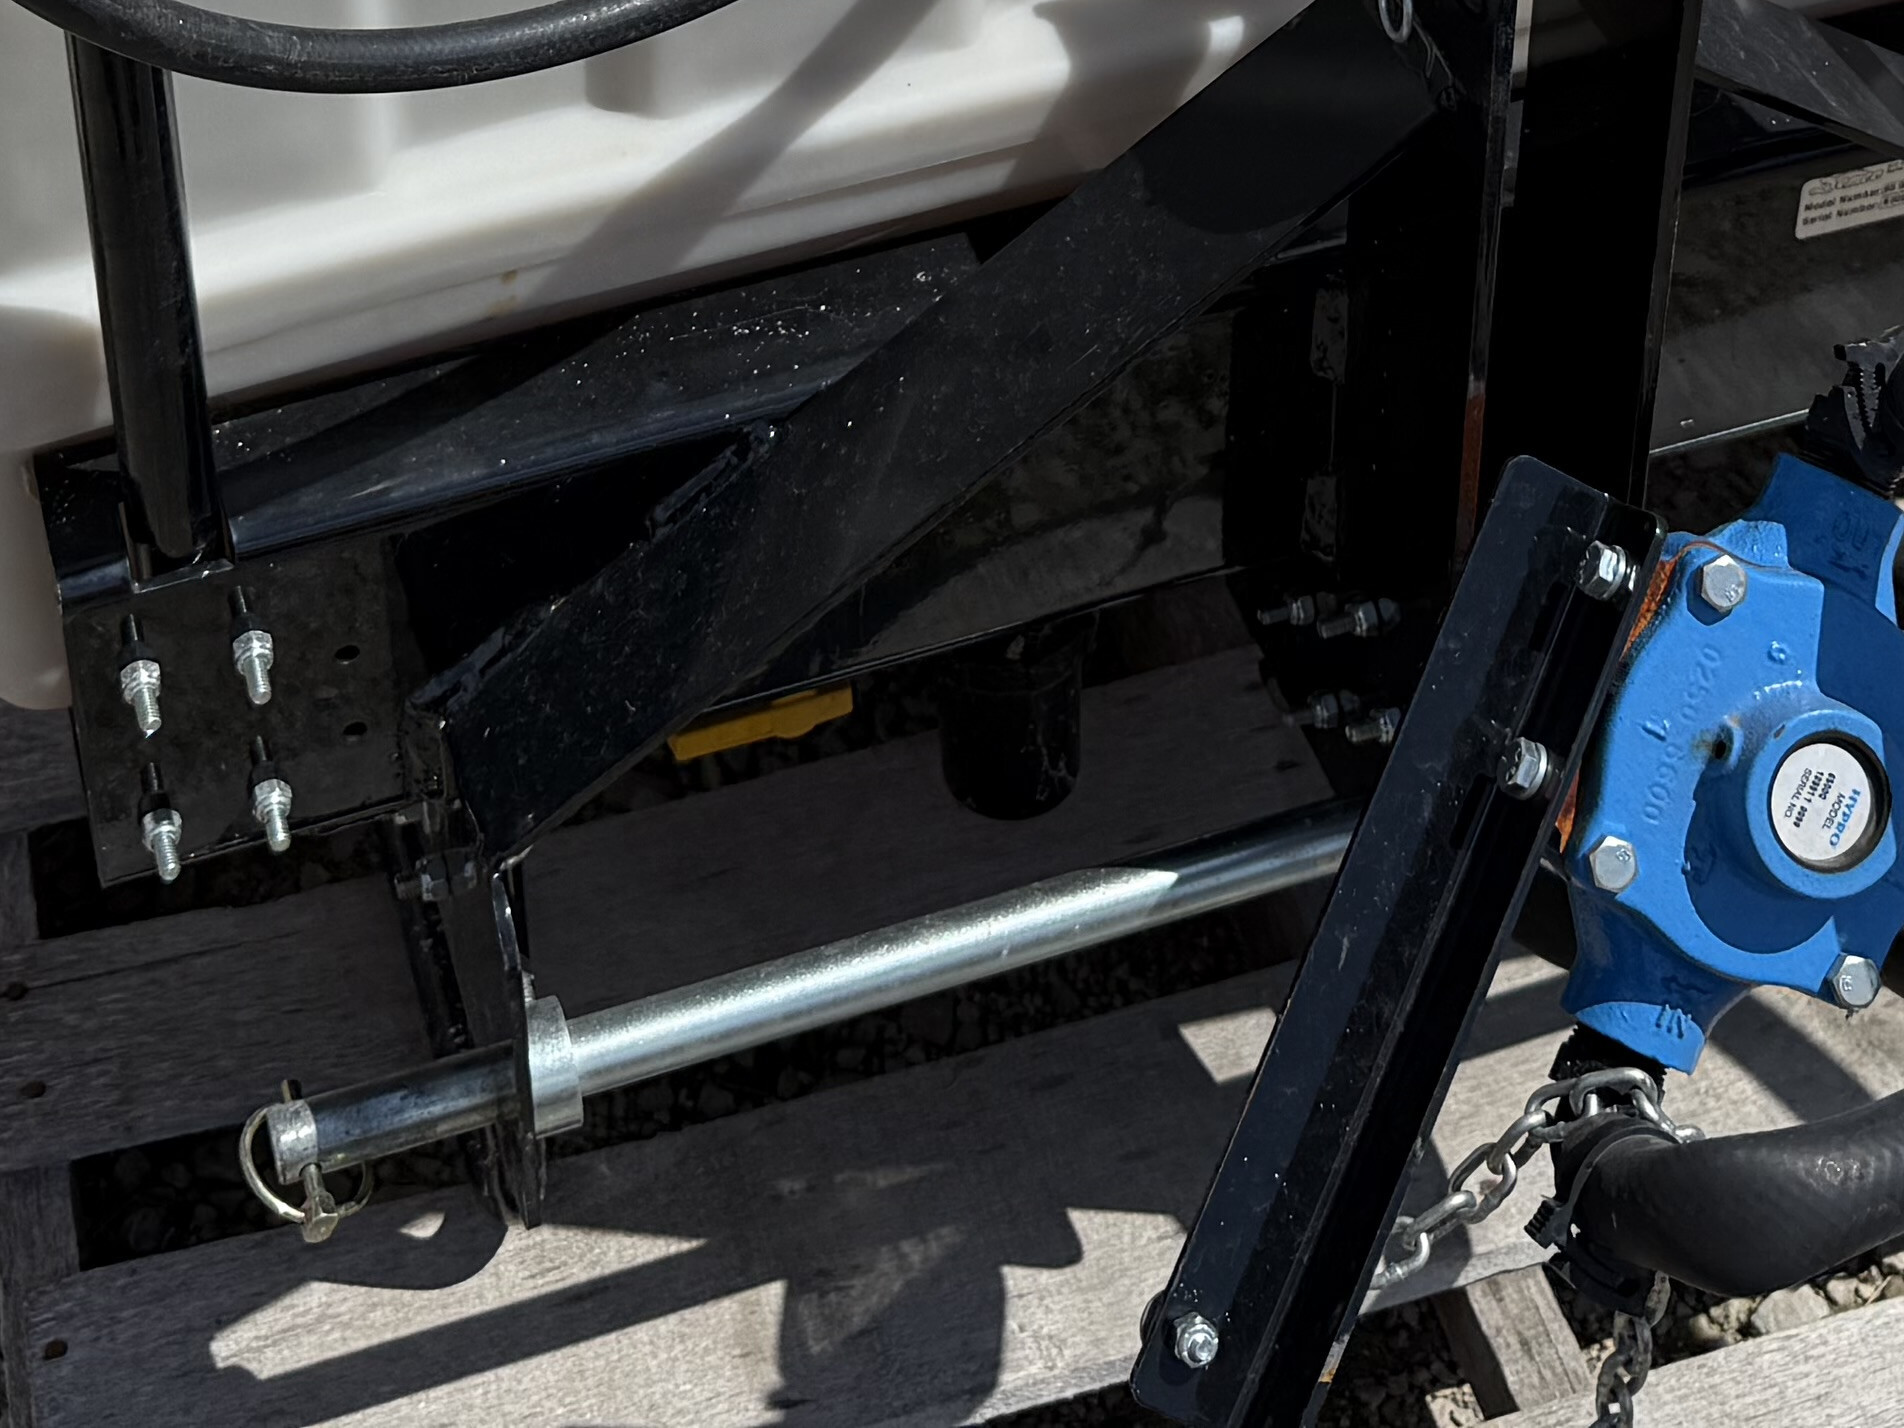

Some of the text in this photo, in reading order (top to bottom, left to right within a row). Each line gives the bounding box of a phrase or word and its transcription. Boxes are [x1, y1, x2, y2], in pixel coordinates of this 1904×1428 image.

[1791, 768, 1813, 800] SERIAL
[1821, 792, 1846, 830] MODEL
[1828, 788, 1861, 847] HYPRO
